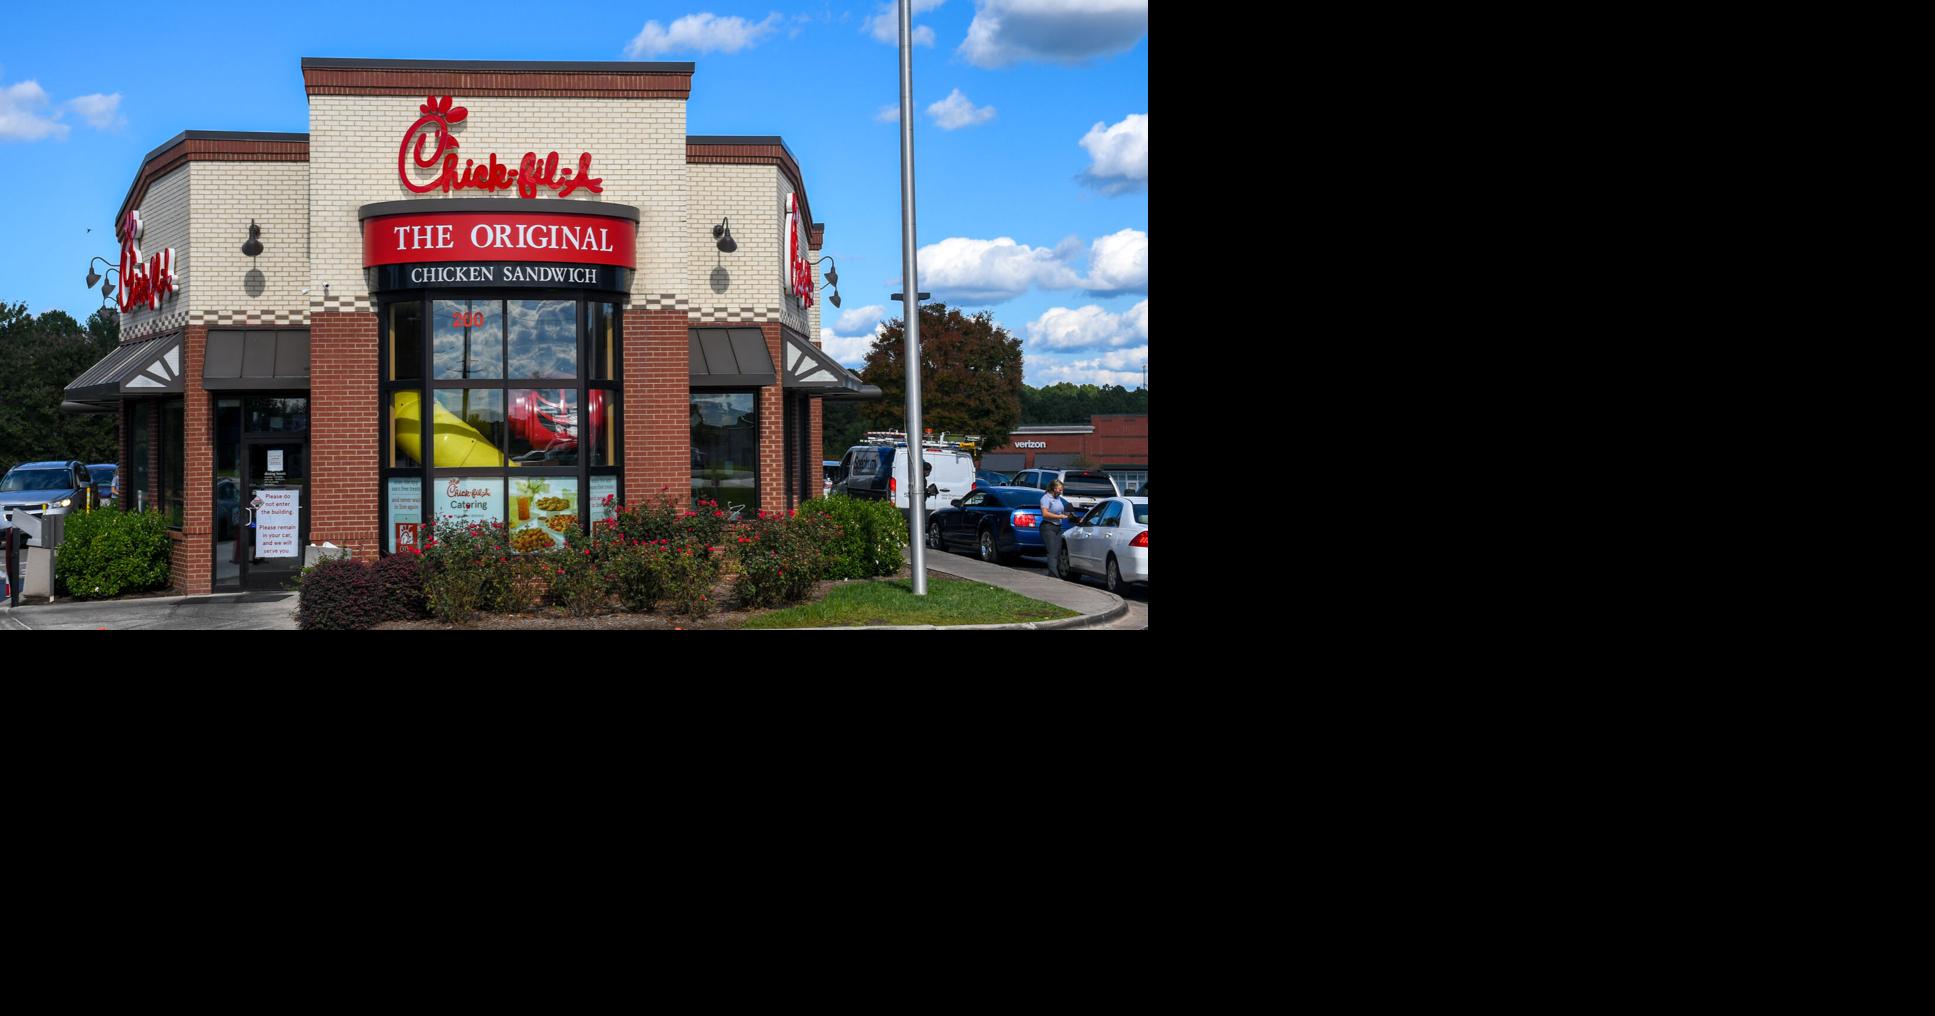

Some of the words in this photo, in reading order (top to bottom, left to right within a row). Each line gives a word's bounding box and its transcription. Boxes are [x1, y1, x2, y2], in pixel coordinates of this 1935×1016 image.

[398, 95, 603, 199] Chick-fil-A
[394, 225, 453, 250] THE
[471, 224, 613, 252] ORIGINAL
[411, 266, 494, 283] CHICKEN
[503, 267, 596, 283] SANDWICH
[452, 311, 484, 328] 200
[1014, 440, 1046, 448] verizon
[450, 500, 487, 510] Catring
